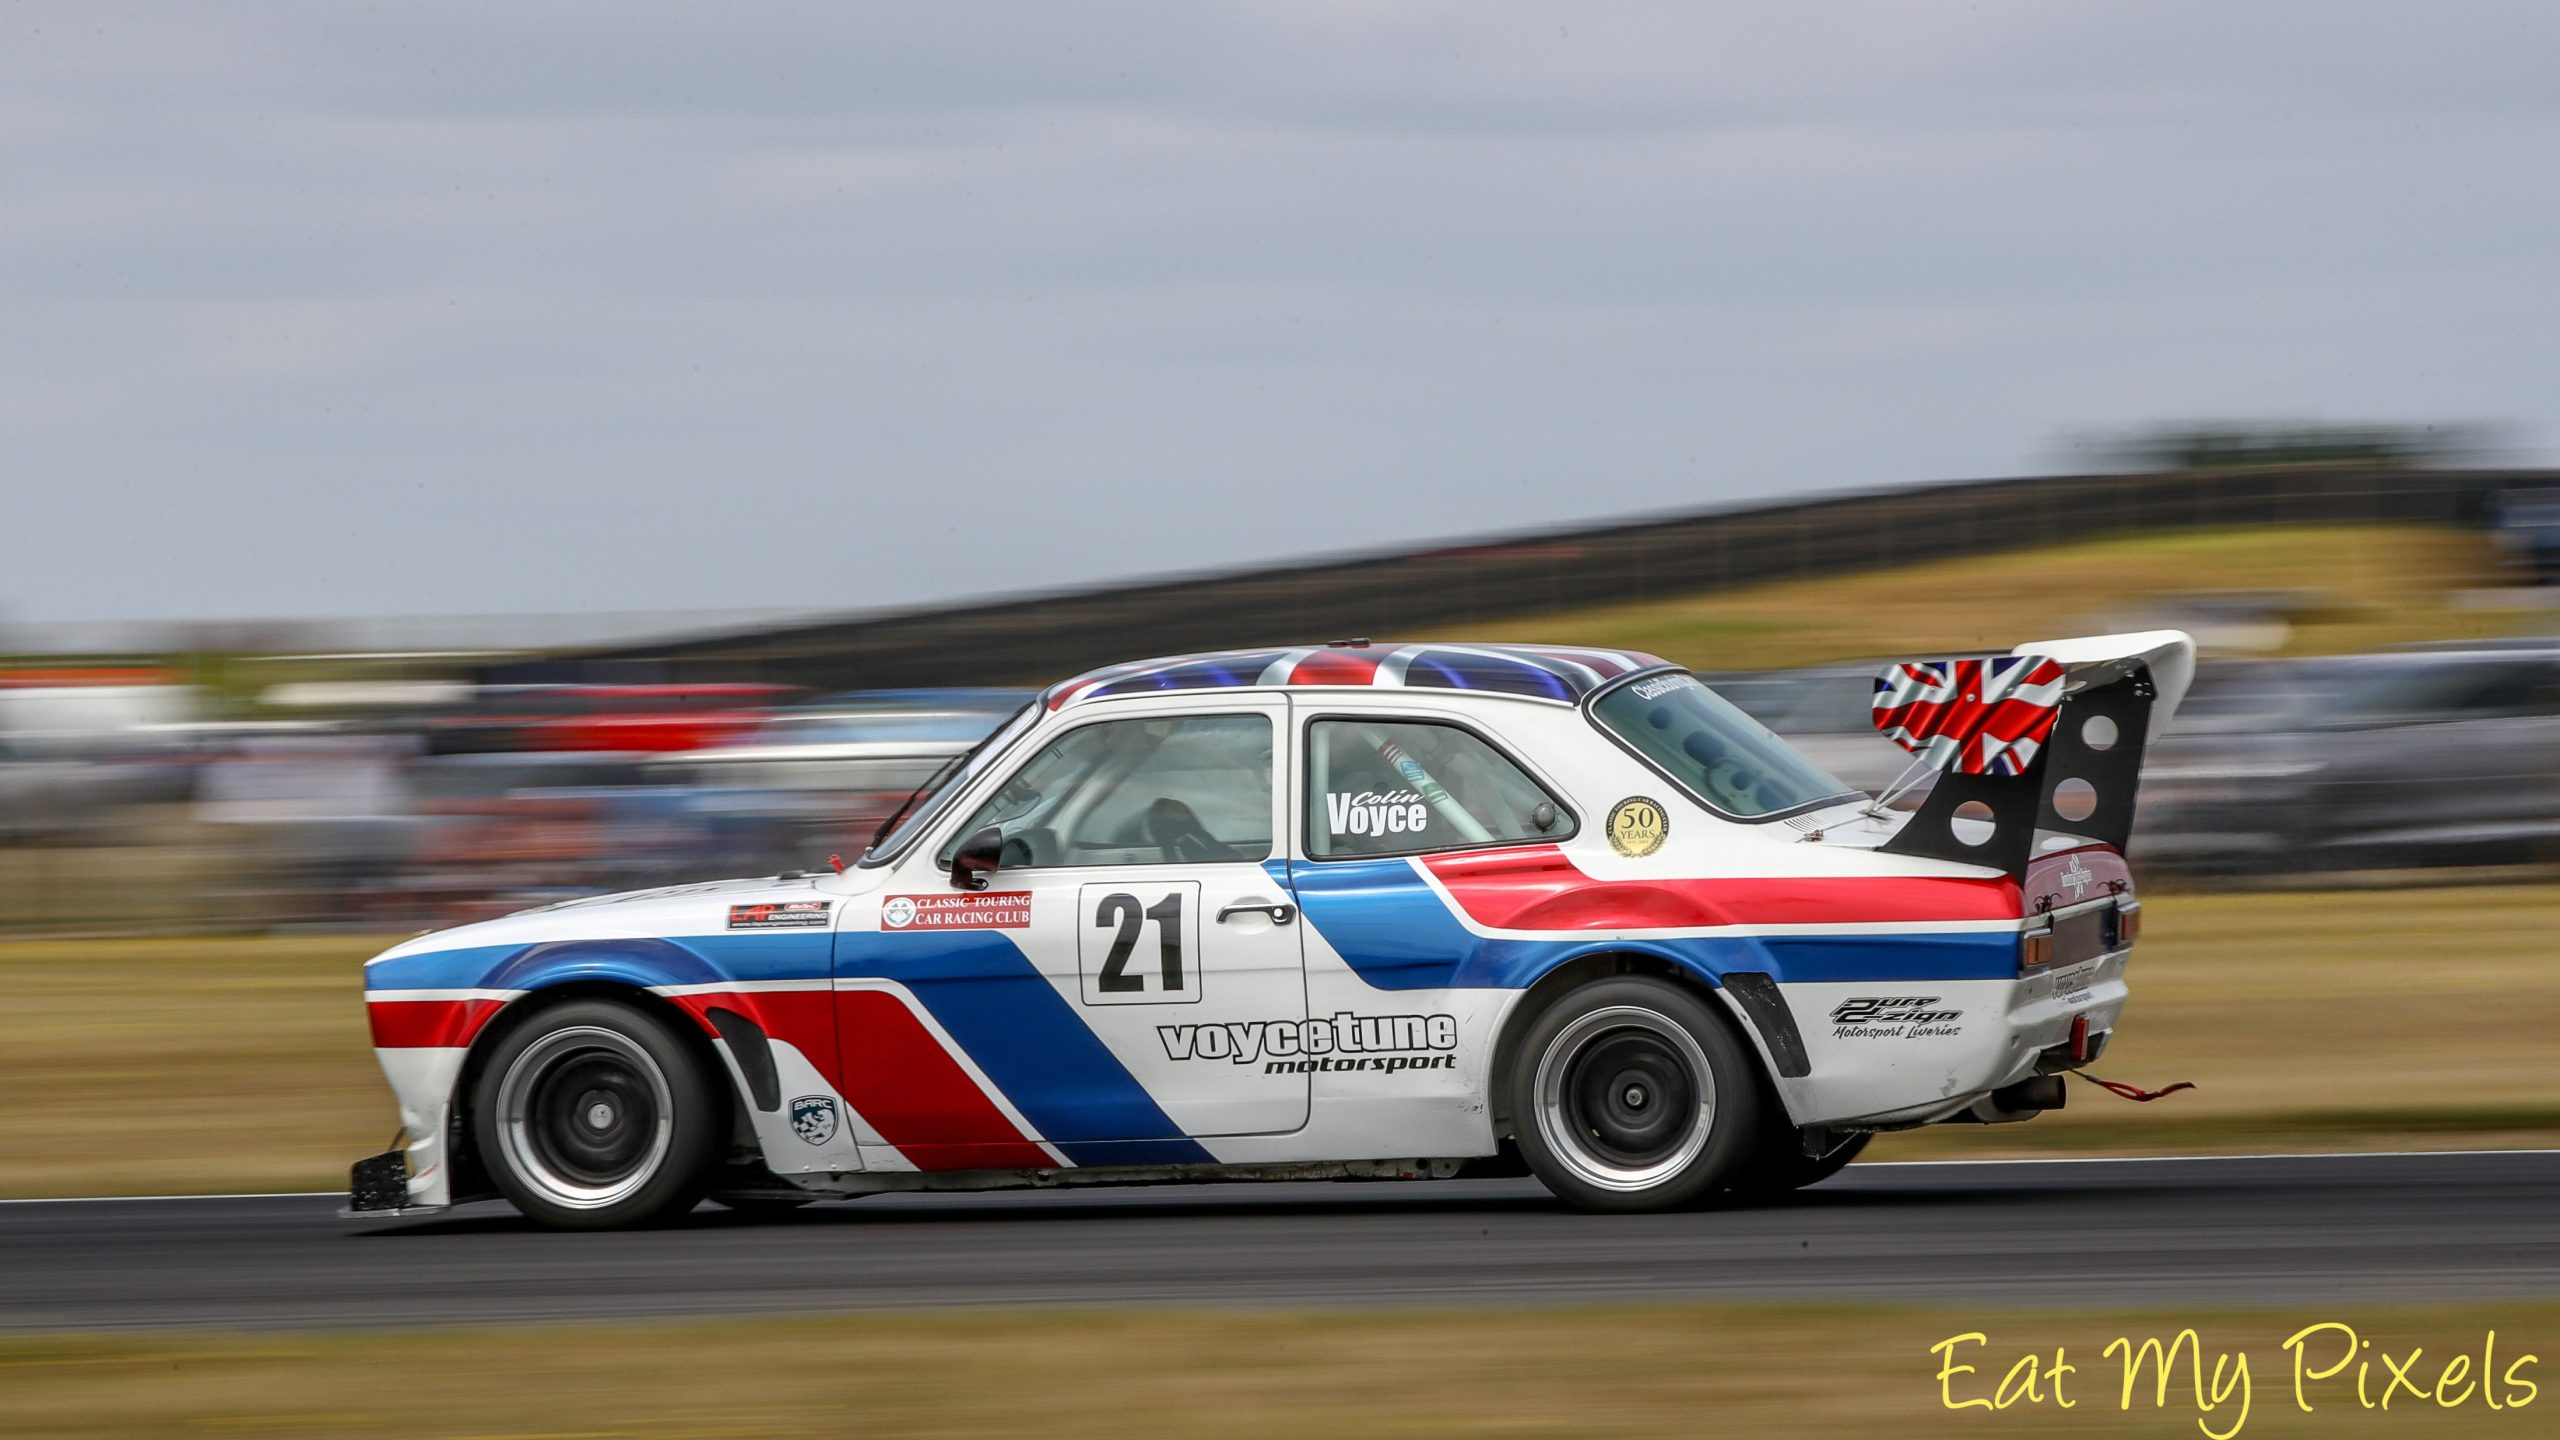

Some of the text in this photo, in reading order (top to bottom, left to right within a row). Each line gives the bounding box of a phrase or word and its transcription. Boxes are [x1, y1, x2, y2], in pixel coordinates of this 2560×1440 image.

[1351, 790, 1424, 806] Colin
[1326, 792, 1427, 837] Voyce
[1621, 807, 1654, 829] 50
[1620, 830, 1655, 839] YEARS
[916, 895, 1030, 908] CLASSIC TOURING
[768, 912, 828, 921] ENGINEERING
[915, 911, 1030, 925] CAR RACING CLUB
[1095, 892, 1184, 993] 21
[1156, 1011, 1458, 1065] voycetune
[1832, 1023, 1961, 1040] Motorsport Liveries
[1264, 1053, 1457, 1075] motorsport
[795, 1100, 832, 1110] BARC
